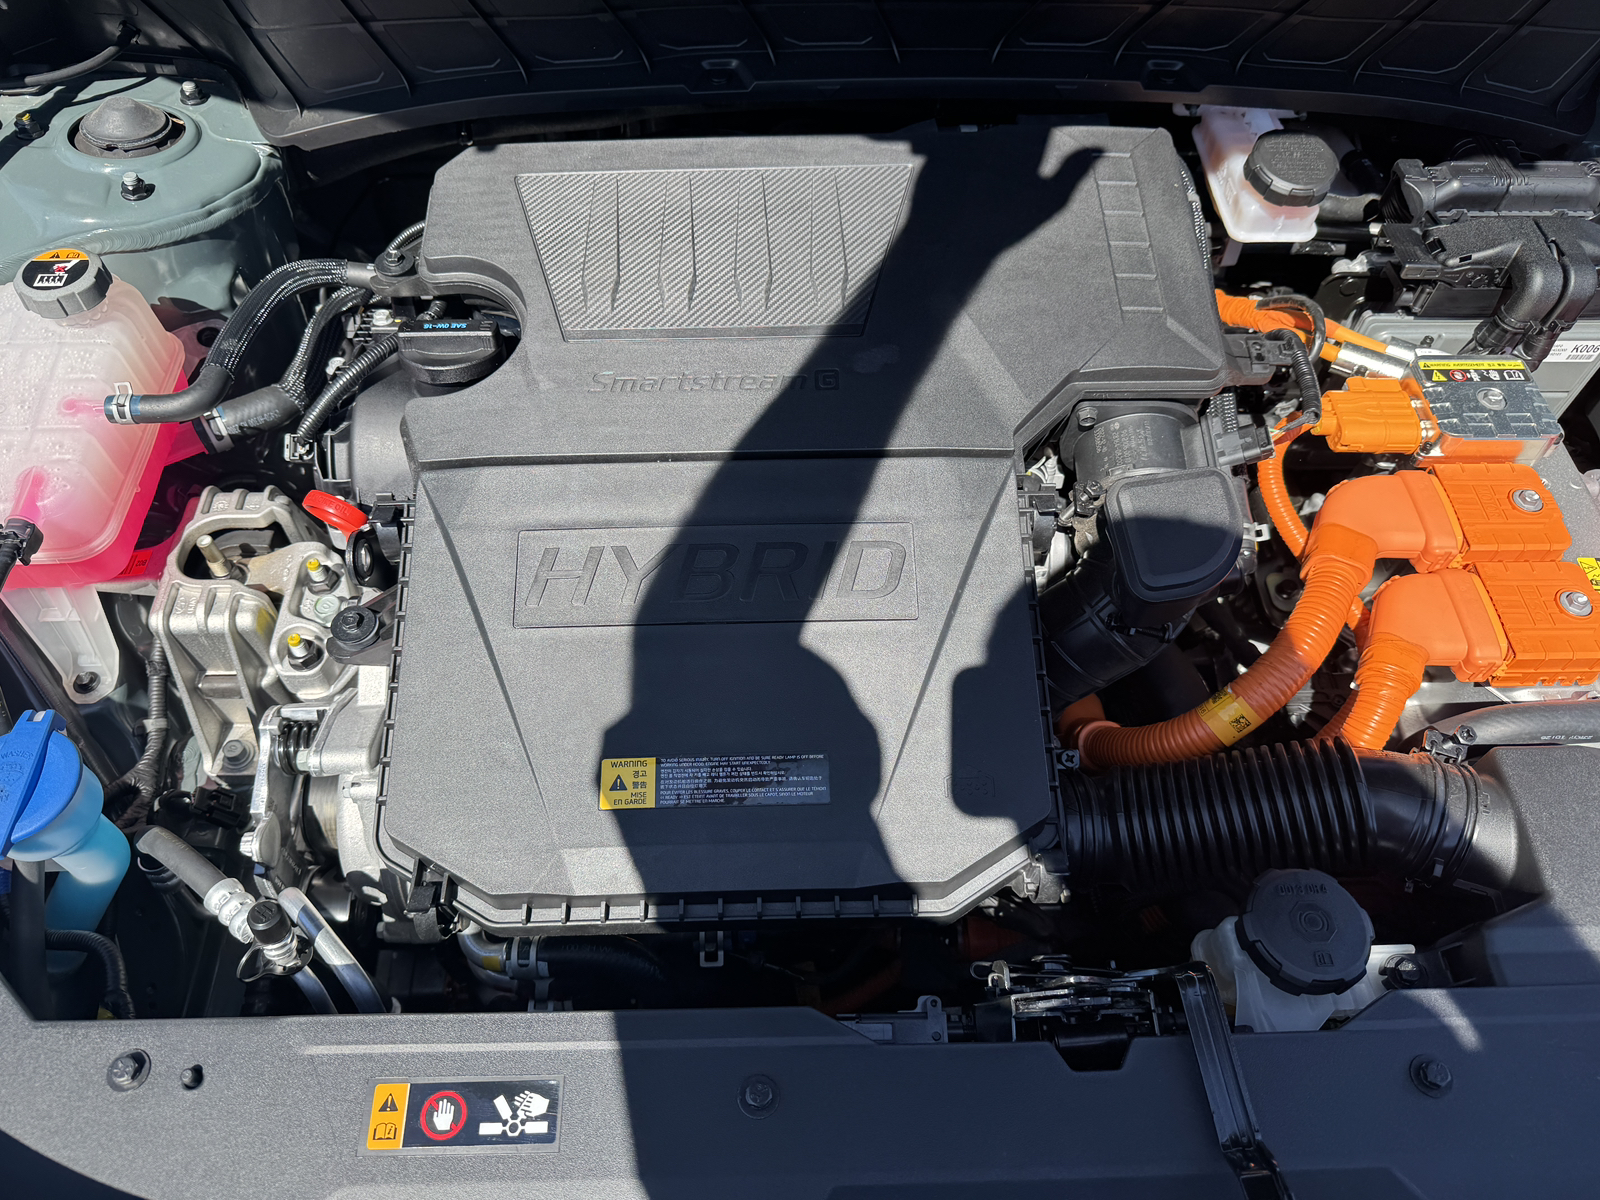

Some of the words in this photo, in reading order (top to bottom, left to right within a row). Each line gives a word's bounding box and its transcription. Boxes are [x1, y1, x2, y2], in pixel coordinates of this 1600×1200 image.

[588, 371, 808, 392] Smartstream
[525, 541, 906, 606] HYBRID
[611, 760, 648, 768] WARNING
